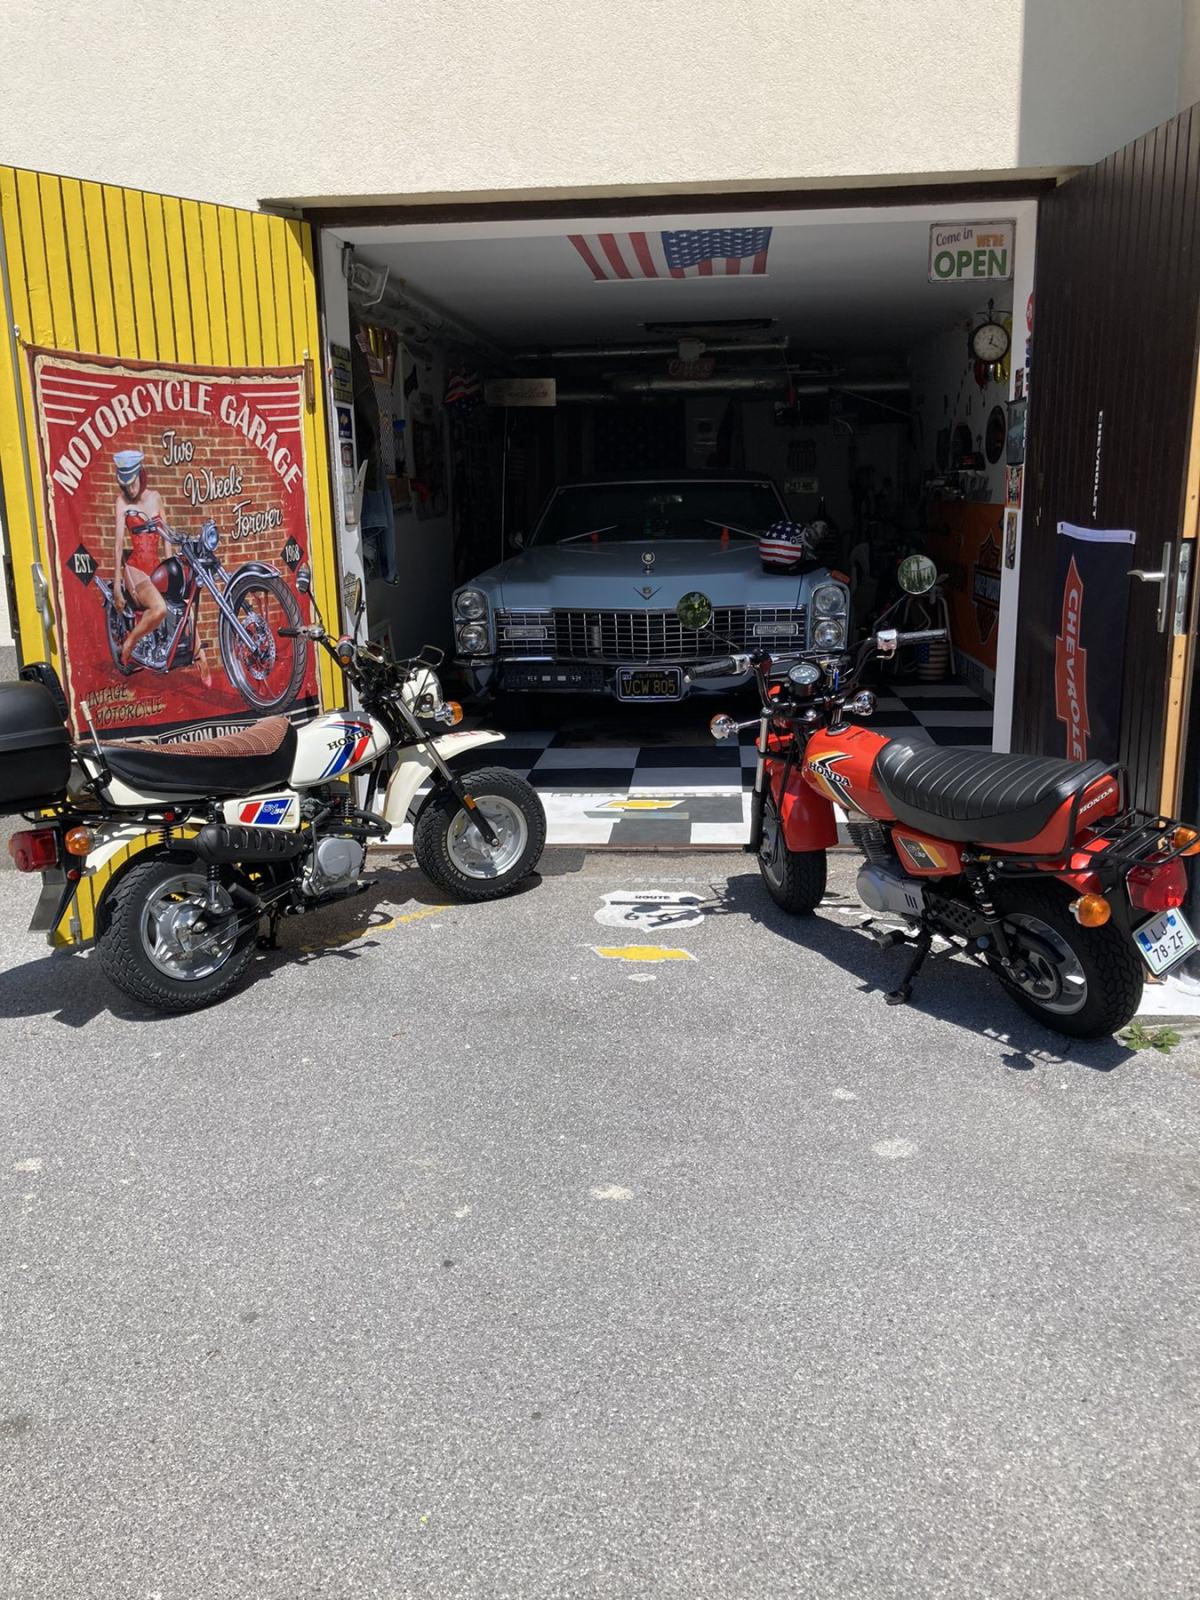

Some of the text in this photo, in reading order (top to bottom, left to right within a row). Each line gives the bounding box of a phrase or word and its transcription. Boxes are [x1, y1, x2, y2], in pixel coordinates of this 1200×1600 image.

[935, 231, 961, 247] Come
[962, 227, 973, 240] in
[934, 249, 1008, 278] OPEN
[52, 380, 304, 496] MOTORCYCLE GARAGE
[161, 430, 196, 467] Two
[183, 464, 243, 506] Wheels
[231, 500, 283, 540] Forever
[284, 545, 300, 563] 1968
[624, 679, 676, 694] VCW 805
[1064, 587, 1082, 762] CHEVROLE
[80, 682, 129, 709] VINTAGE
[215, 725, 249, 739] PART
[327, 729, 373, 751] HONDA
[809, 762, 852, 788] HONDA
[1079, 787, 1114, 815] HONDA
[1150, 920, 1168, 941] LJ
[1152, 930, 1184, 963] 78-ZF
